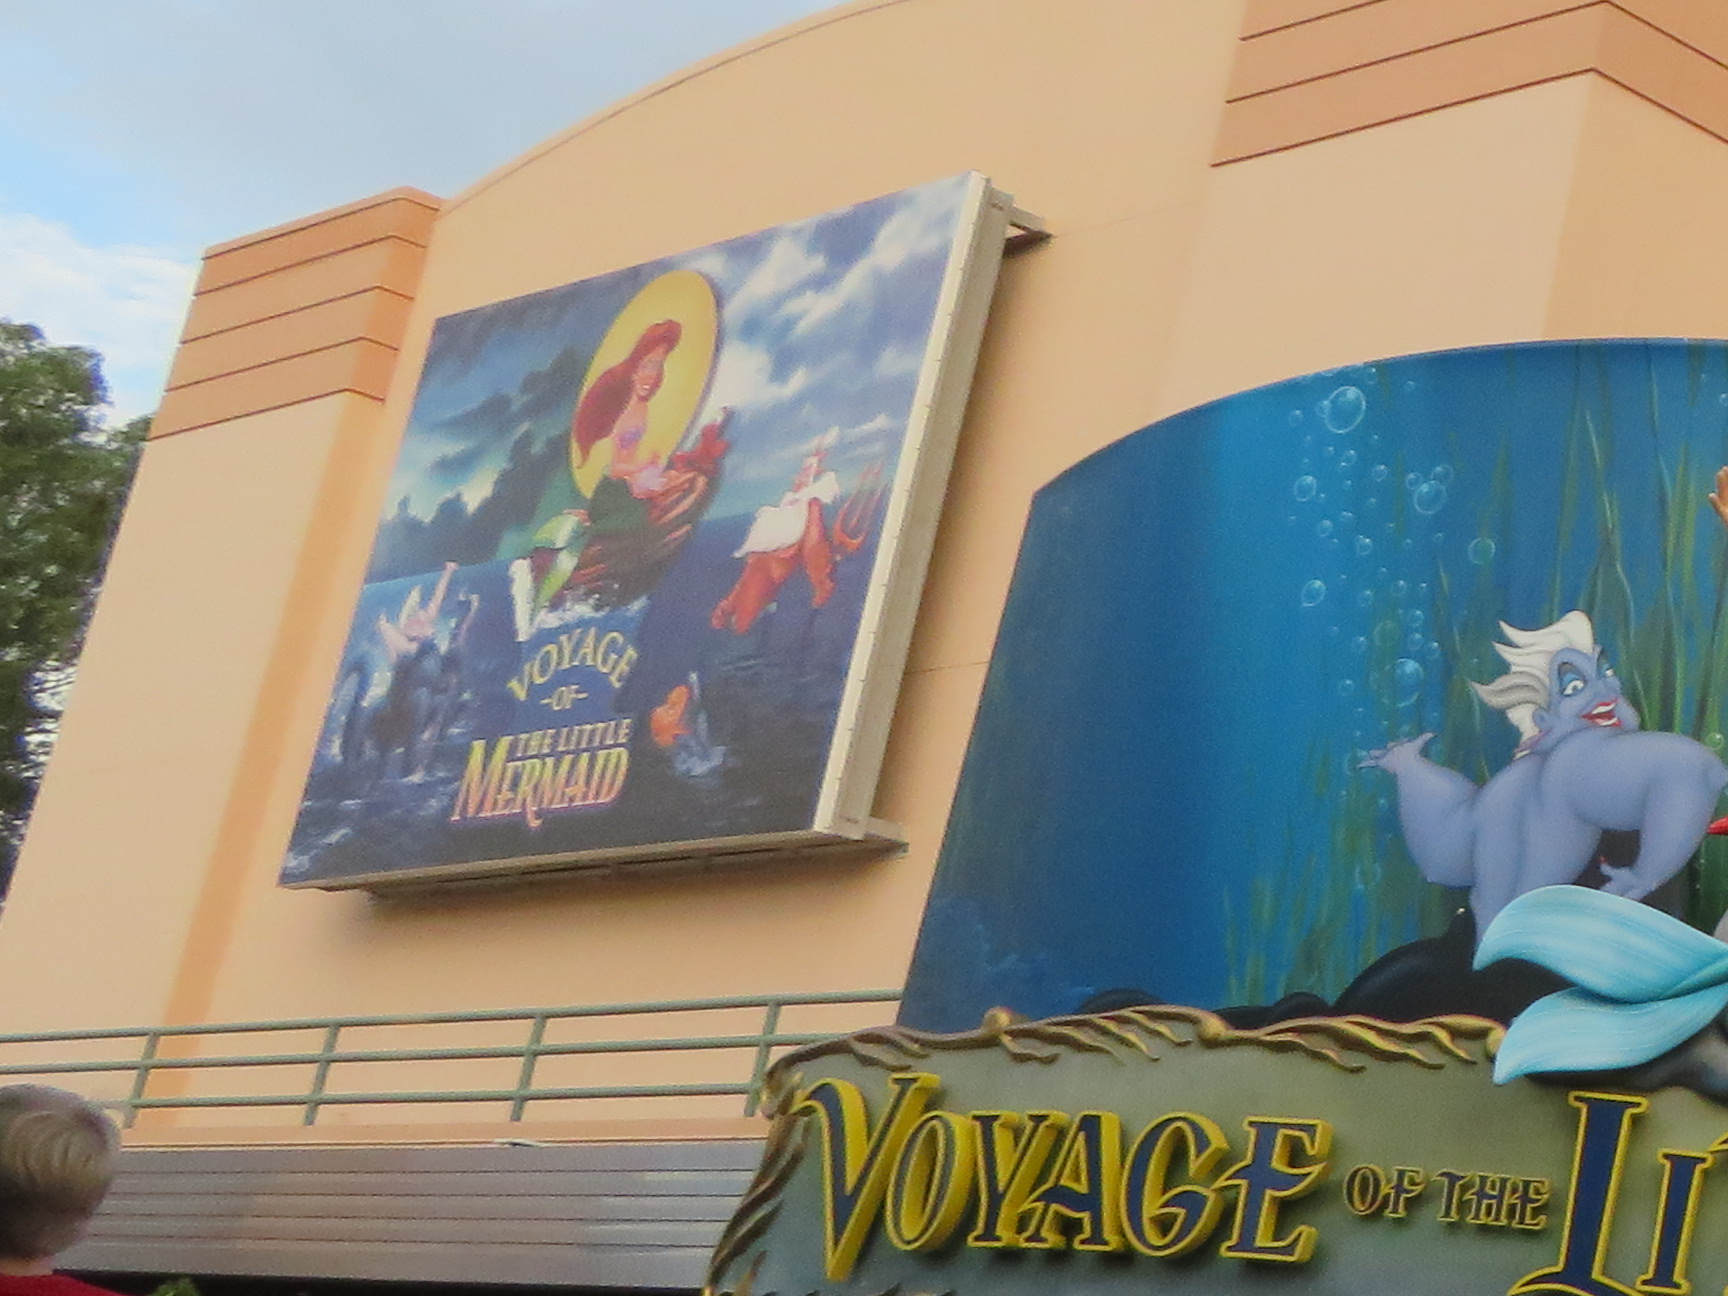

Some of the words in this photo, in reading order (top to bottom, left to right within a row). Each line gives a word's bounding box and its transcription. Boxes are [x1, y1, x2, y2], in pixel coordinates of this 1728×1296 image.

[507, 626, 637, 702] VOYAGE
[514, 728, 556, 757] THE
[557, 717, 632, 751] LITTLE
[450, 739, 629, 827] MERMAID
[797, 1072, 1331, 1282] VOYAGE
[1343, 1164, 1427, 1218] OF
[1430, 1168, 1551, 1230] THE
